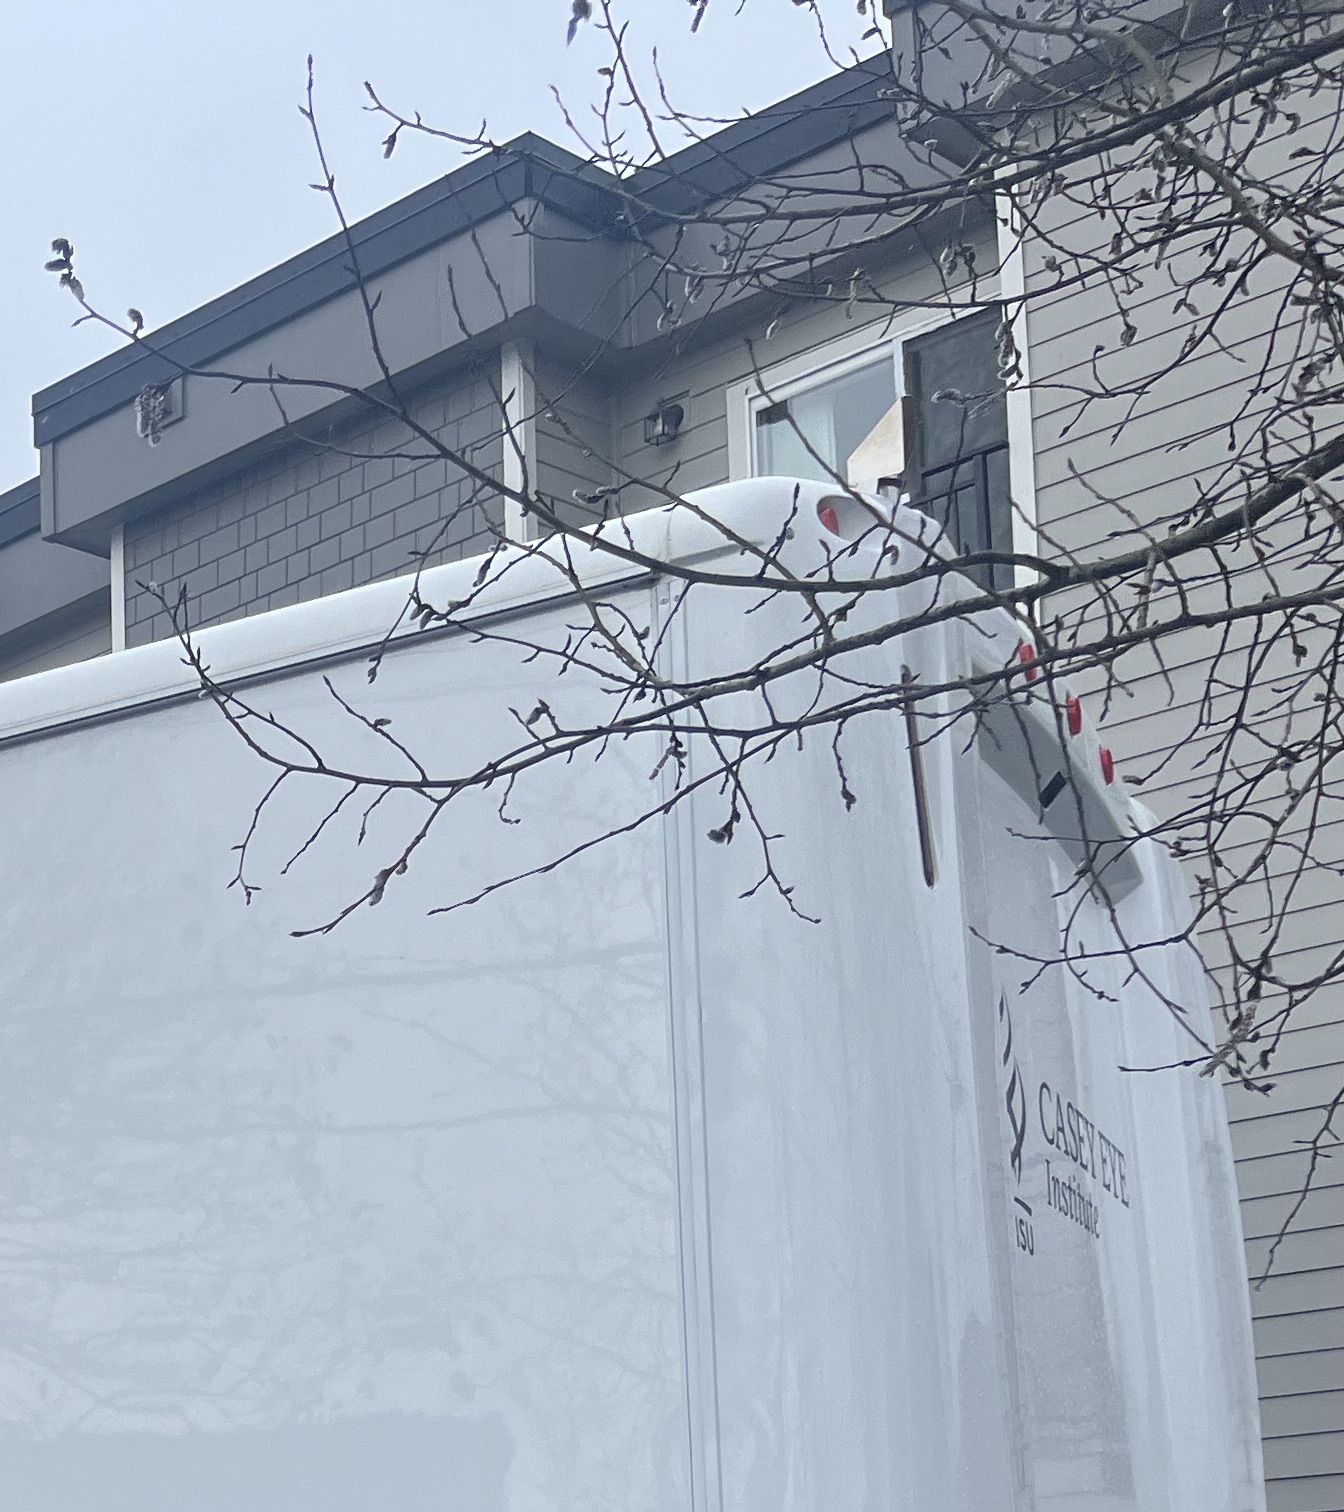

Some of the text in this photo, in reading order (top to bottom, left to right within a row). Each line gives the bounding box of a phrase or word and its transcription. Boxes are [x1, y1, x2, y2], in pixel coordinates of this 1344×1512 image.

[1039, 1082, 1129, 1208] CASEY EYE
[1045, 1158, 1100, 1238] Institute
